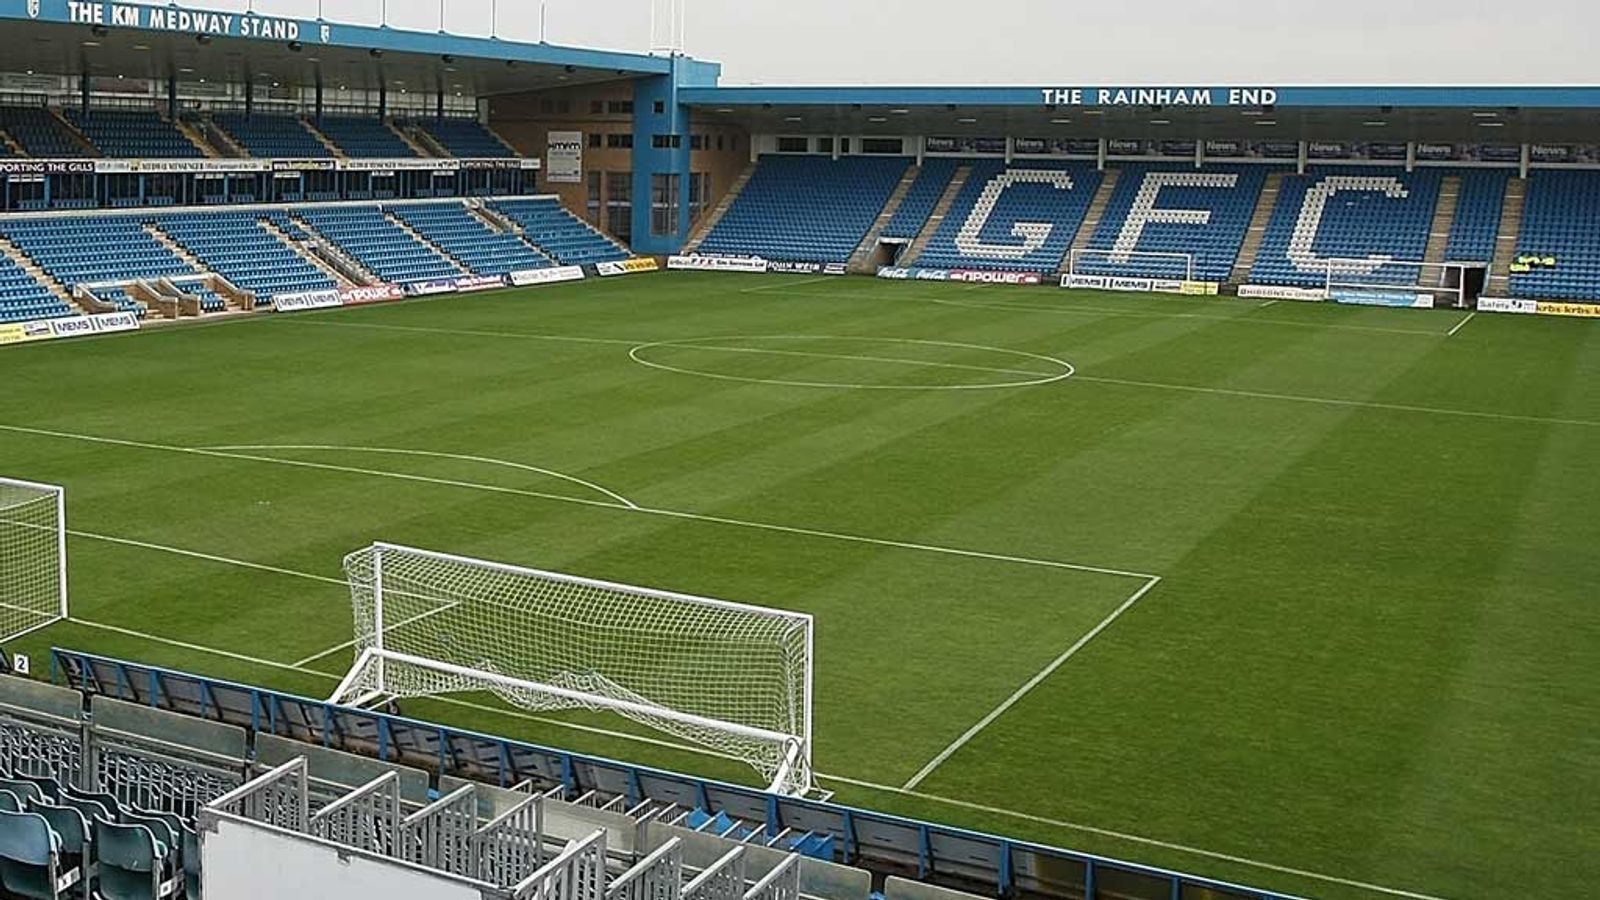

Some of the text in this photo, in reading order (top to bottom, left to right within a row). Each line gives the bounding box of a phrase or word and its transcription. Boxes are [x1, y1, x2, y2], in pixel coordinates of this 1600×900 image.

[68, 2, 299, 39] THE KM MEDWAY STAND
[1042, 89, 1277, 105] THE RAINHAM END
[48, 162, 67, 172] THE
[68, 162, 94, 172] GILLS
[963, 271, 1024, 283] npower
[1071, 277, 1101, 286] MEMS
[1115, 280, 1148, 288] MEMS
[57, 320, 90, 332] MEMS
[100, 317, 131, 327] MEMS
[17, 657, 25, 670] 2
